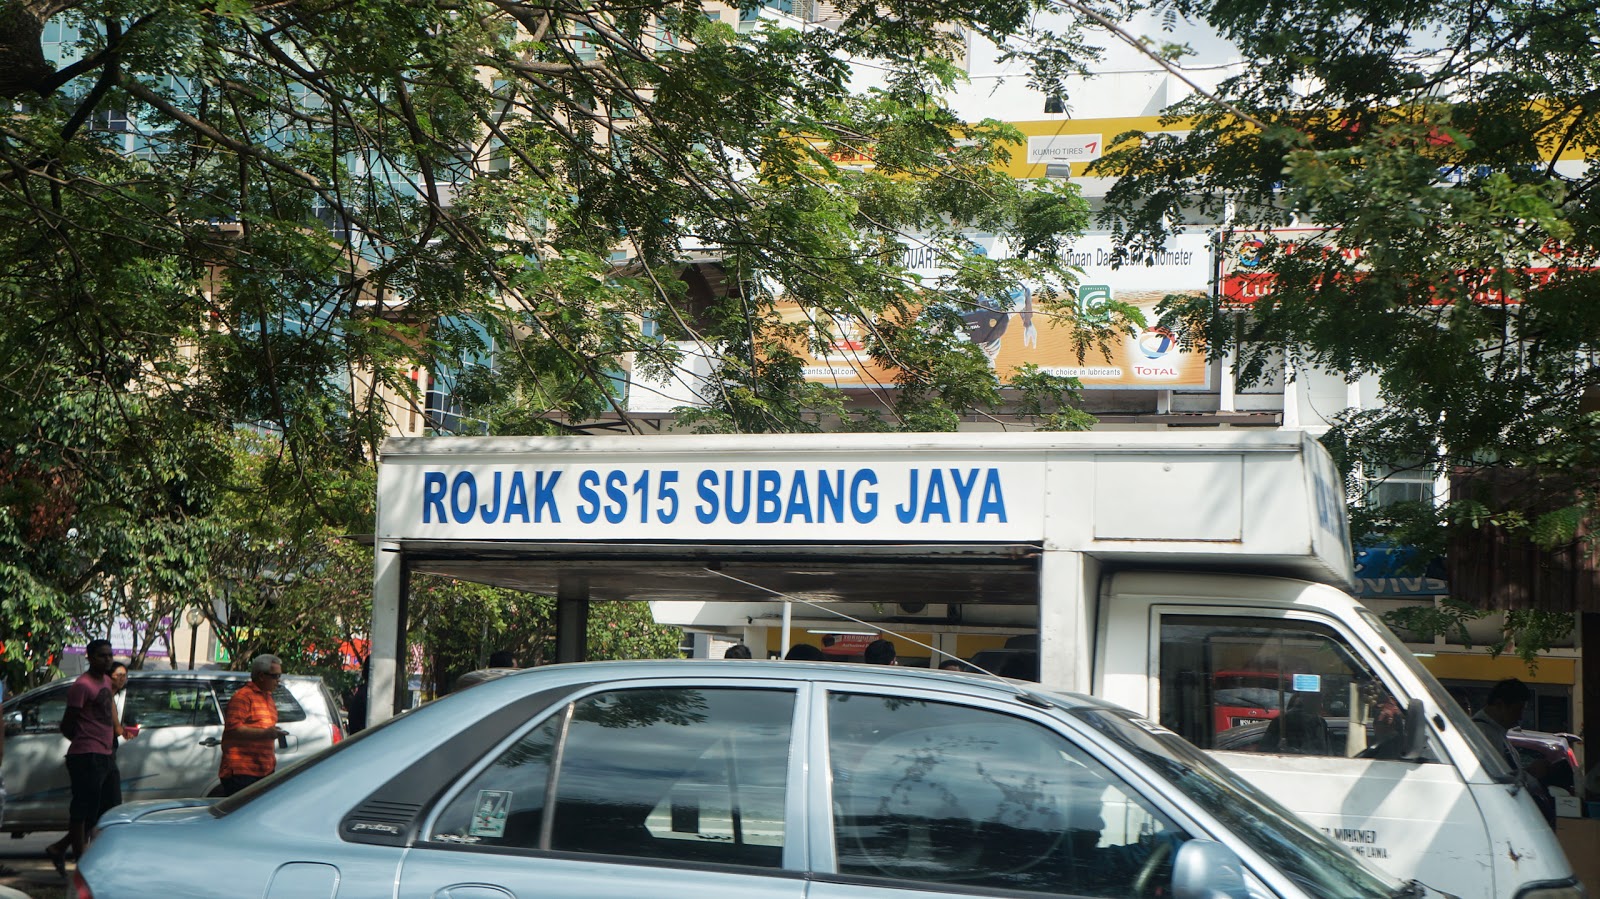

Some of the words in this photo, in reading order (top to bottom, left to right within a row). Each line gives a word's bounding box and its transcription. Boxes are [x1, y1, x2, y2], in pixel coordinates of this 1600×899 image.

[1032, 148, 1061, 156] KUMHO
[1062, 147, 1083, 155] TIRES
[1147, 247, 1193, 266] ilometer
[1055, 368, 1077, 376] choice
[1079, 368, 1086, 376] in
[1087, 368, 1121, 376] lubricants
[1134, 366, 1178, 376] TOTAL
[422, 470, 563, 524] ROJAK
[576, 469, 679, 524] SS15
[694, 468, 879, 524] SUBANG
[895, 468, 1008, 524] JAYA
